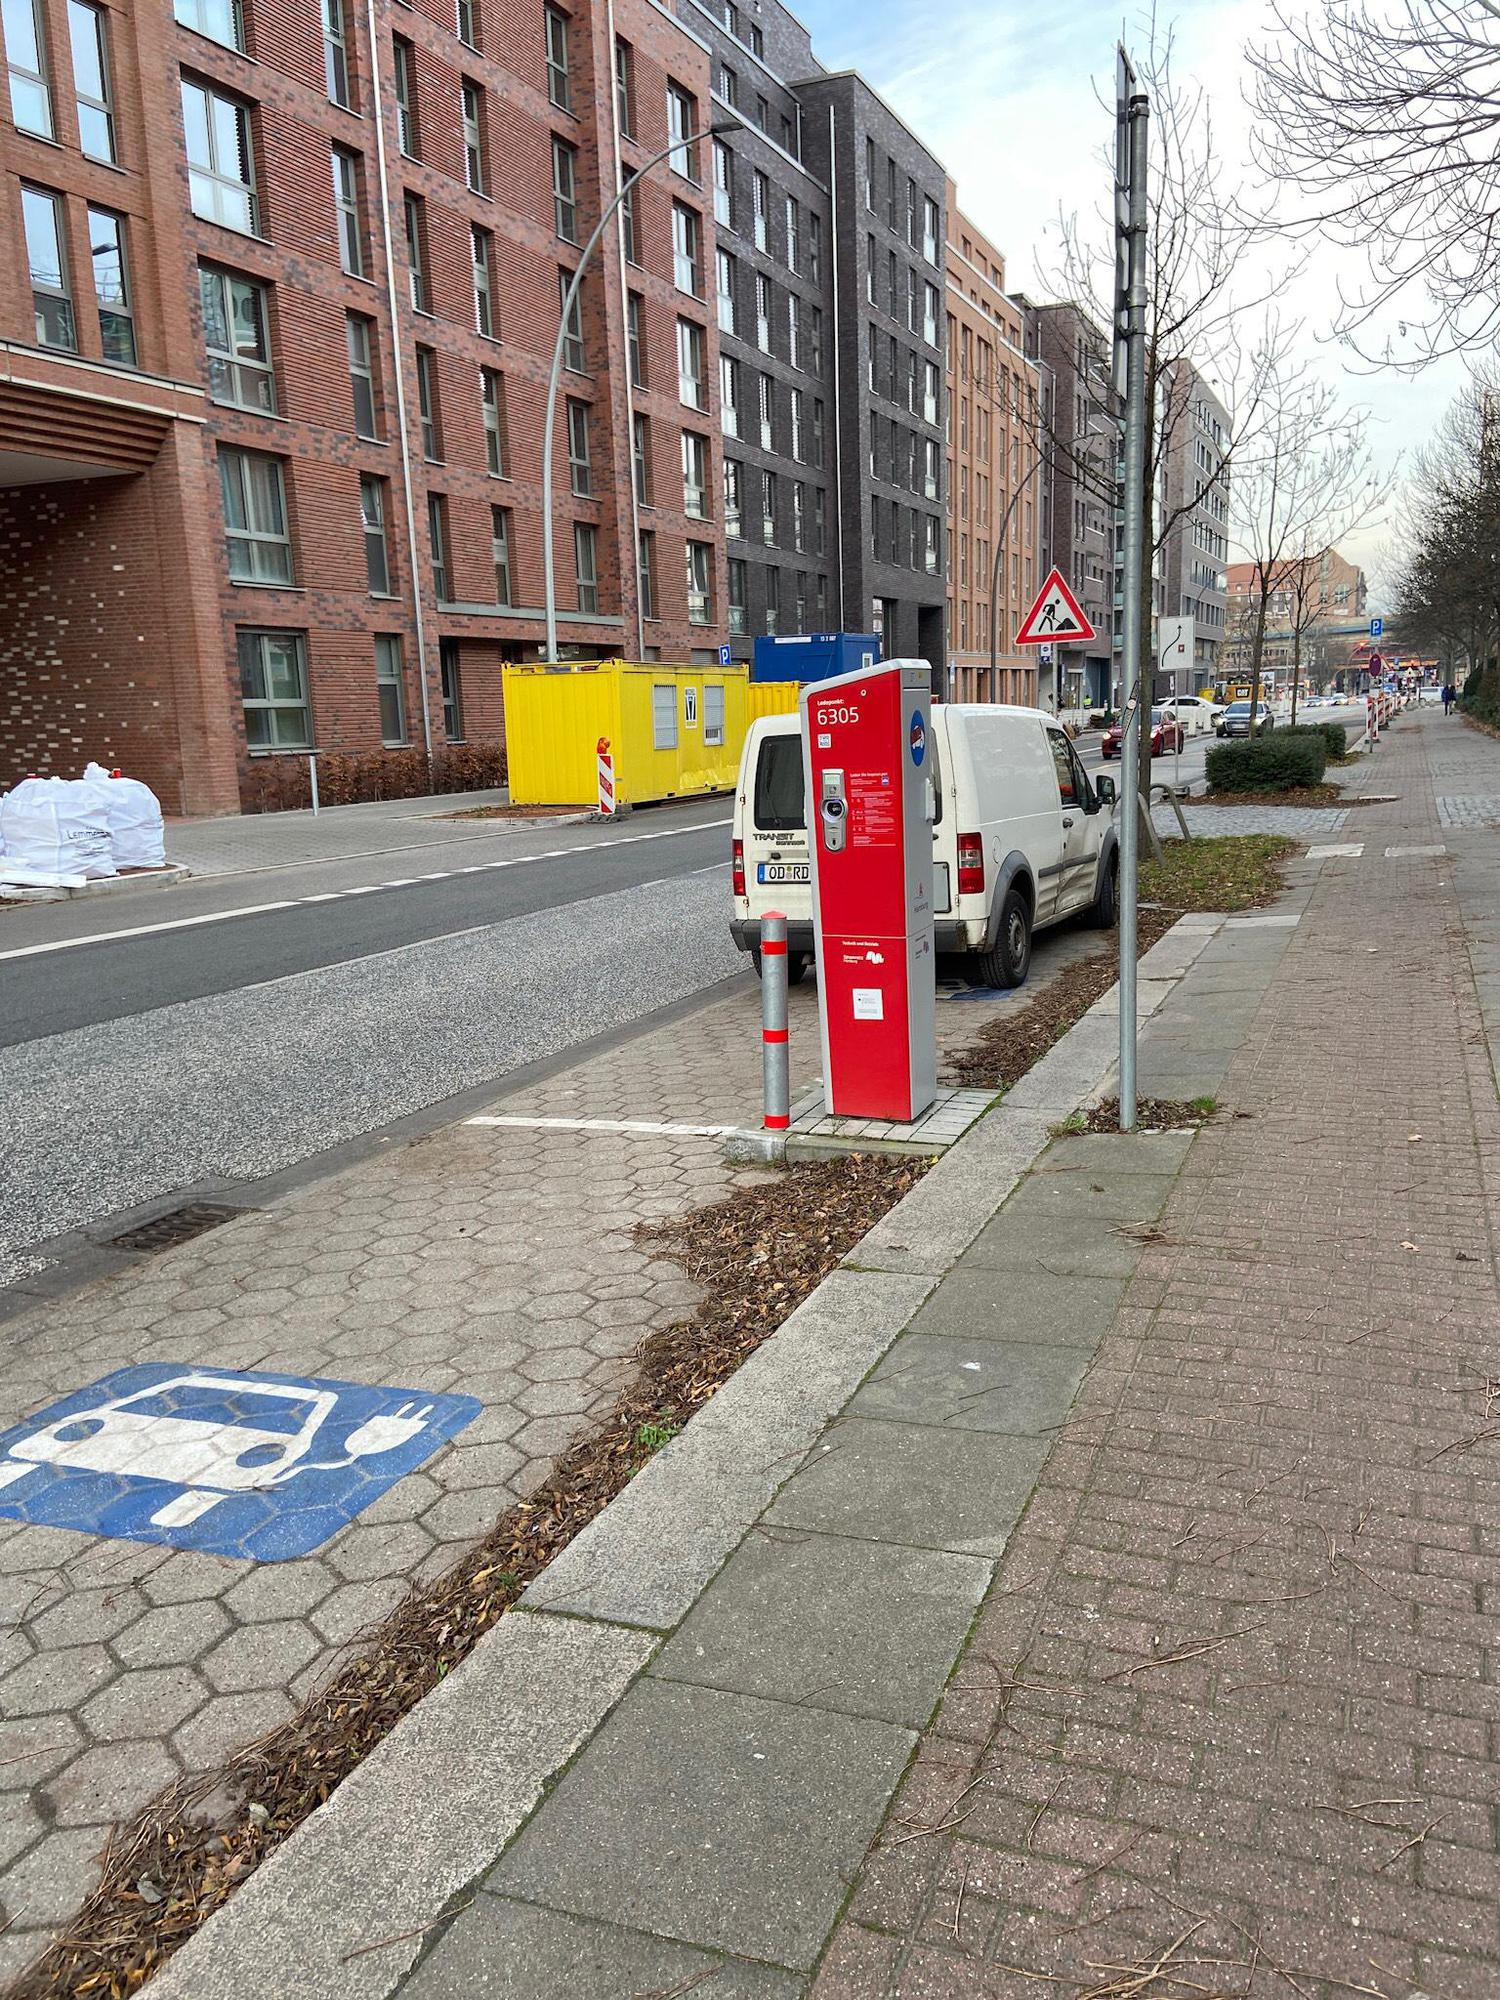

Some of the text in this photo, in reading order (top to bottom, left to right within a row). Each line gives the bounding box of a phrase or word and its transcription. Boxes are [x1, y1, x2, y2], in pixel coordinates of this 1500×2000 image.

[1372, 620, 1380, 635] P
[721, 648, 729, 665] P
[1236, 688, 1250, 697] CAT
[816, 706, 860, 726] 6305
[752, 833, 795, 841] TRANSIT
[768, 866, 785, 880] OD
